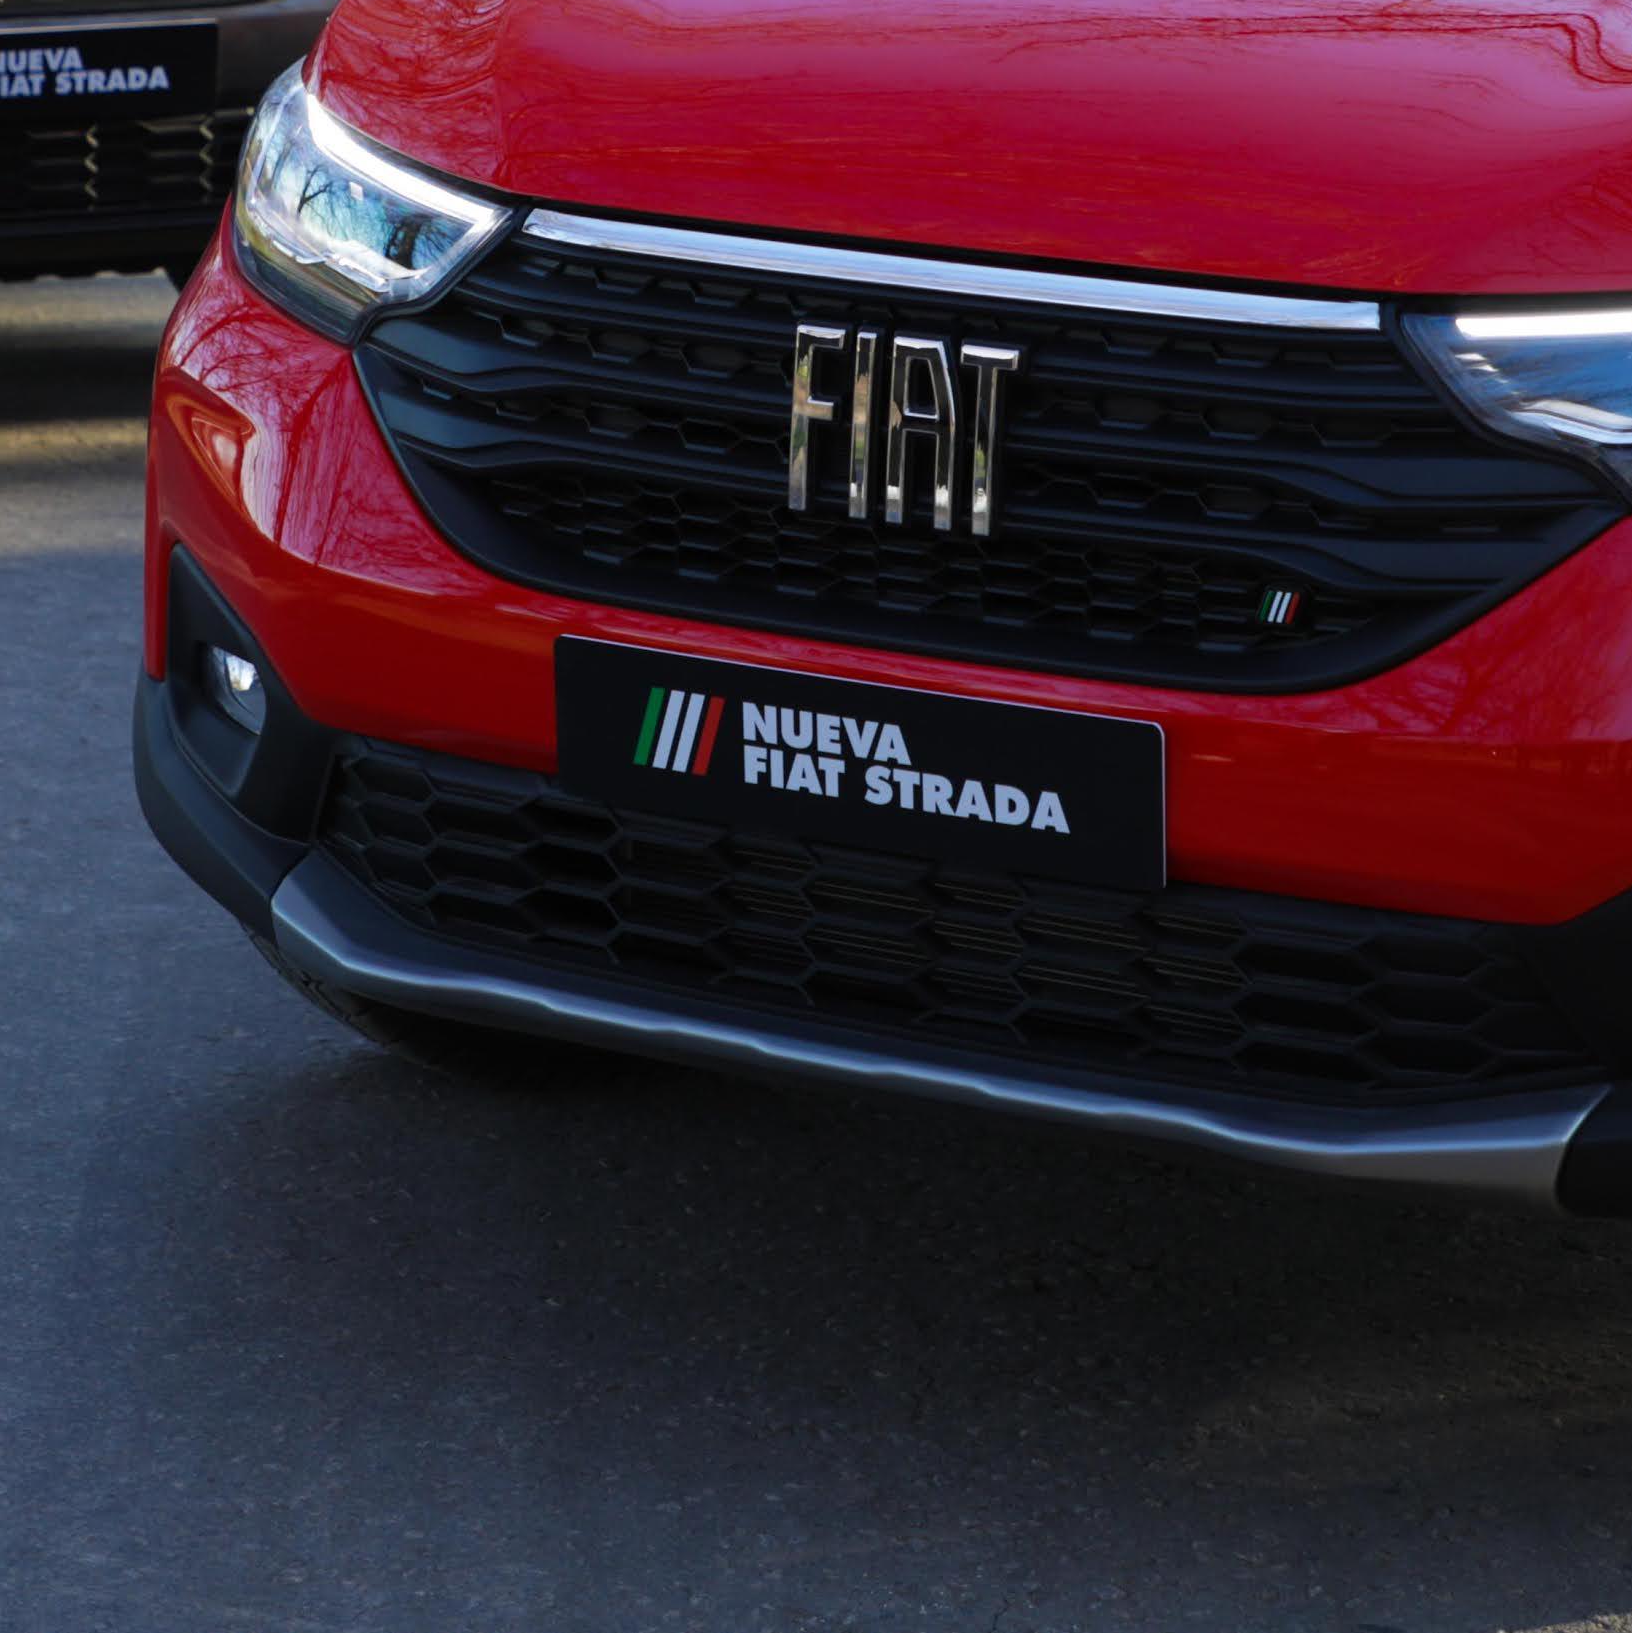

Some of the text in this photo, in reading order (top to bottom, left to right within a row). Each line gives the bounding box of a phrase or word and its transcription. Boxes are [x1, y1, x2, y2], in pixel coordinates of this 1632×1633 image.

[55, 65, 170, 95] STRADA
[788, 324, 1020, 537] FIAT
[742, 701, 912, 766] NUEVA
[743, 744, 1071, 835] FIAT STRADA
